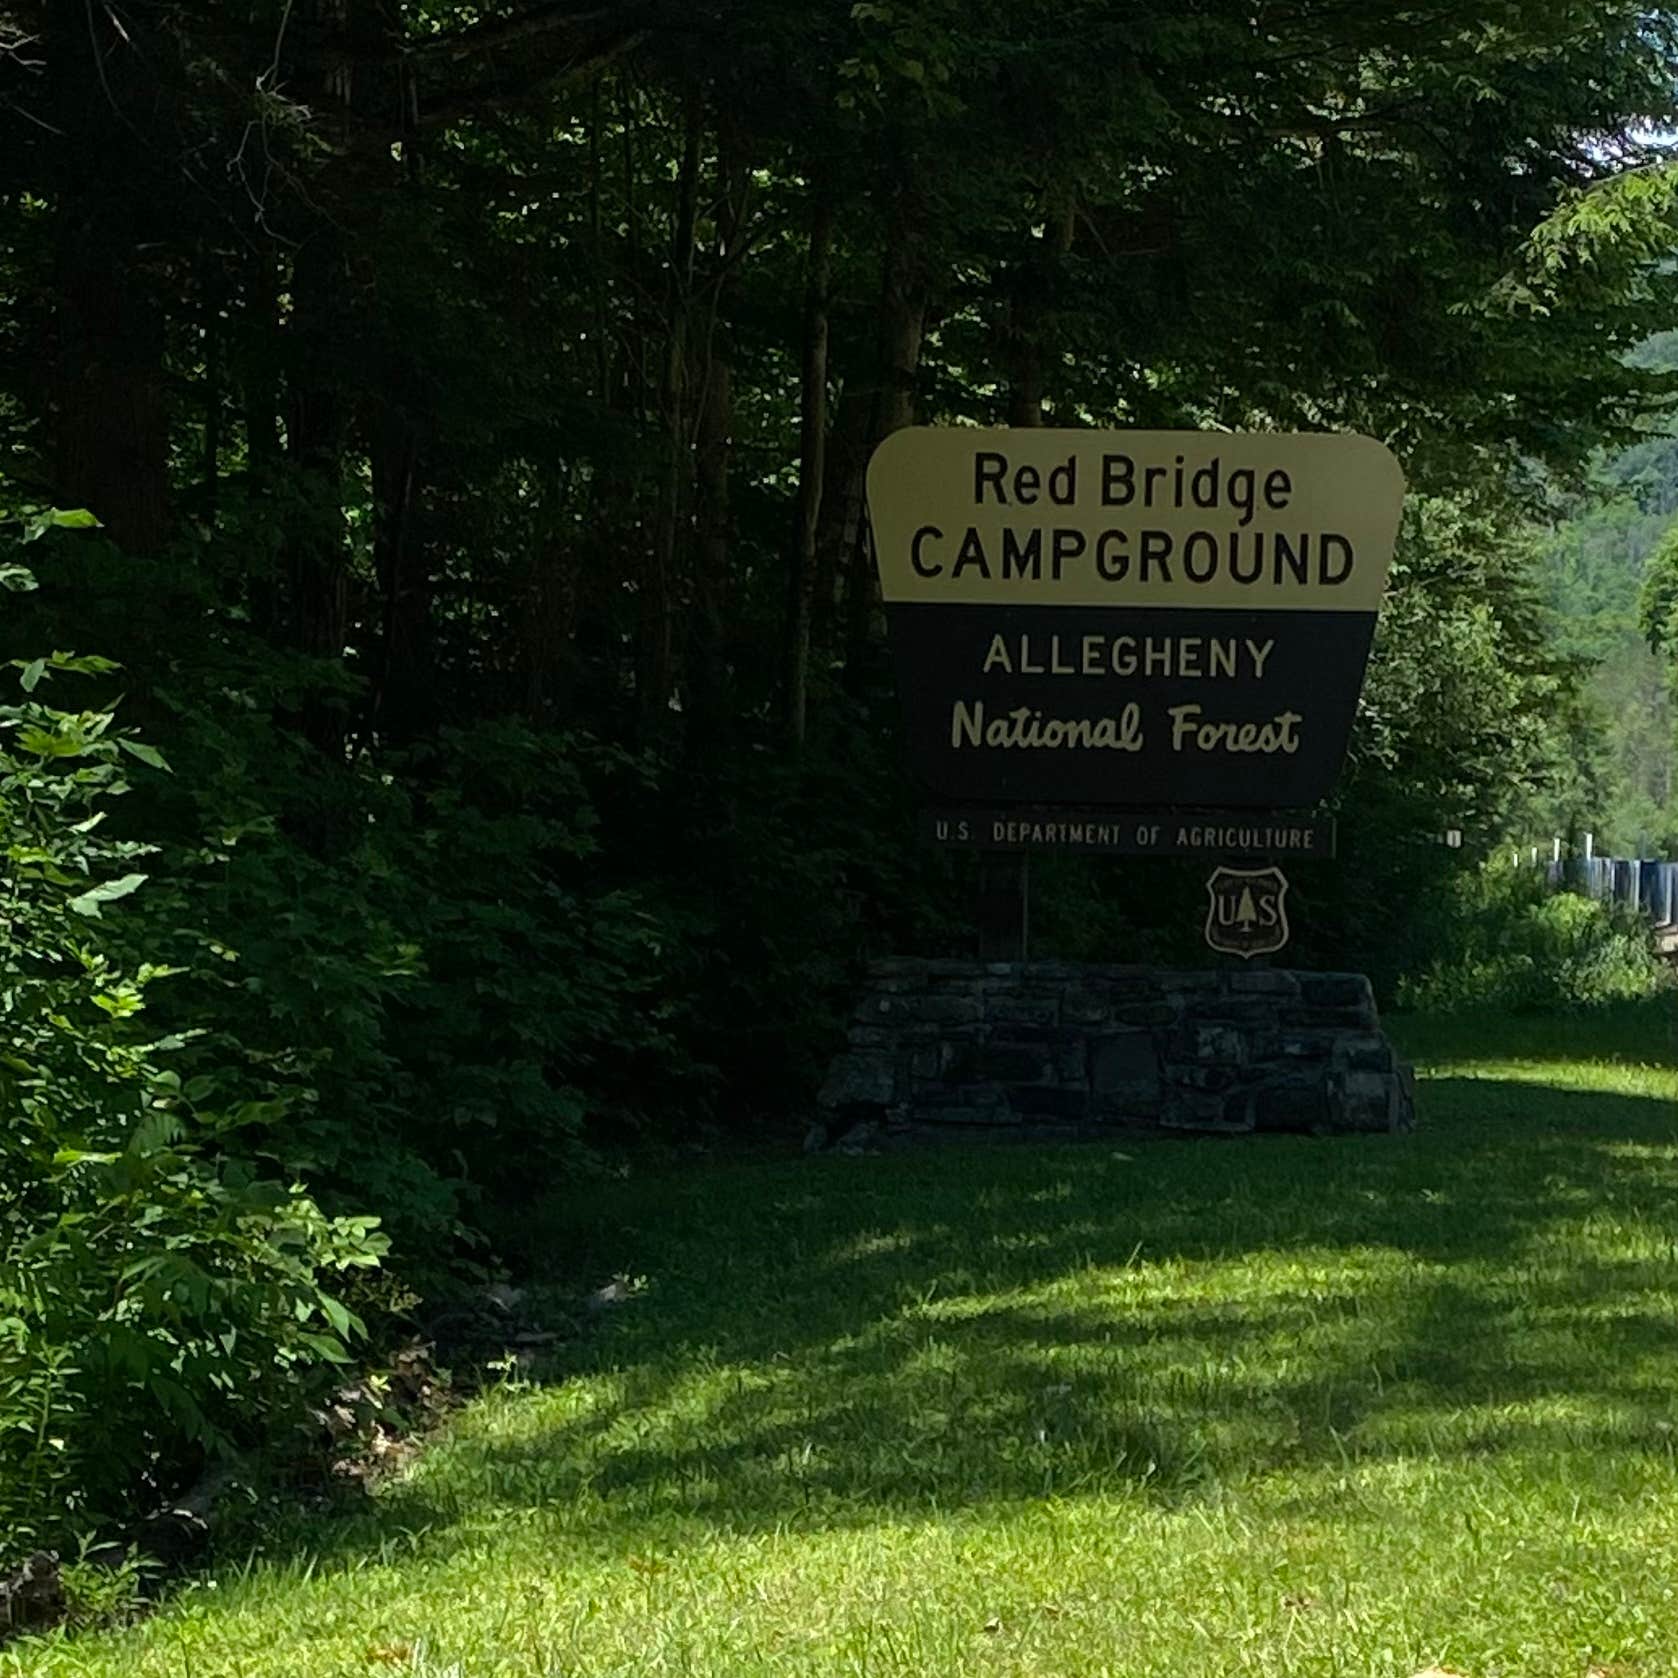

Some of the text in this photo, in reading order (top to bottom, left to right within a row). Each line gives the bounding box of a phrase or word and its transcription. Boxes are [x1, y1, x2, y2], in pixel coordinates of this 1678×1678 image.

[974, 451, 1292, 528] Red Bridge
[911, 525, 1354, 586] CAMPGROUND
[982, 634, 1275, 679] ALLEGHENY
[951, 701, 1302, 754] National Forest
[992, 822, 1120, 845] DEPARTMENT
[1136, 826, 1159, 846] OF
[1176, 827, 1314, 849] AGRICULTURE
